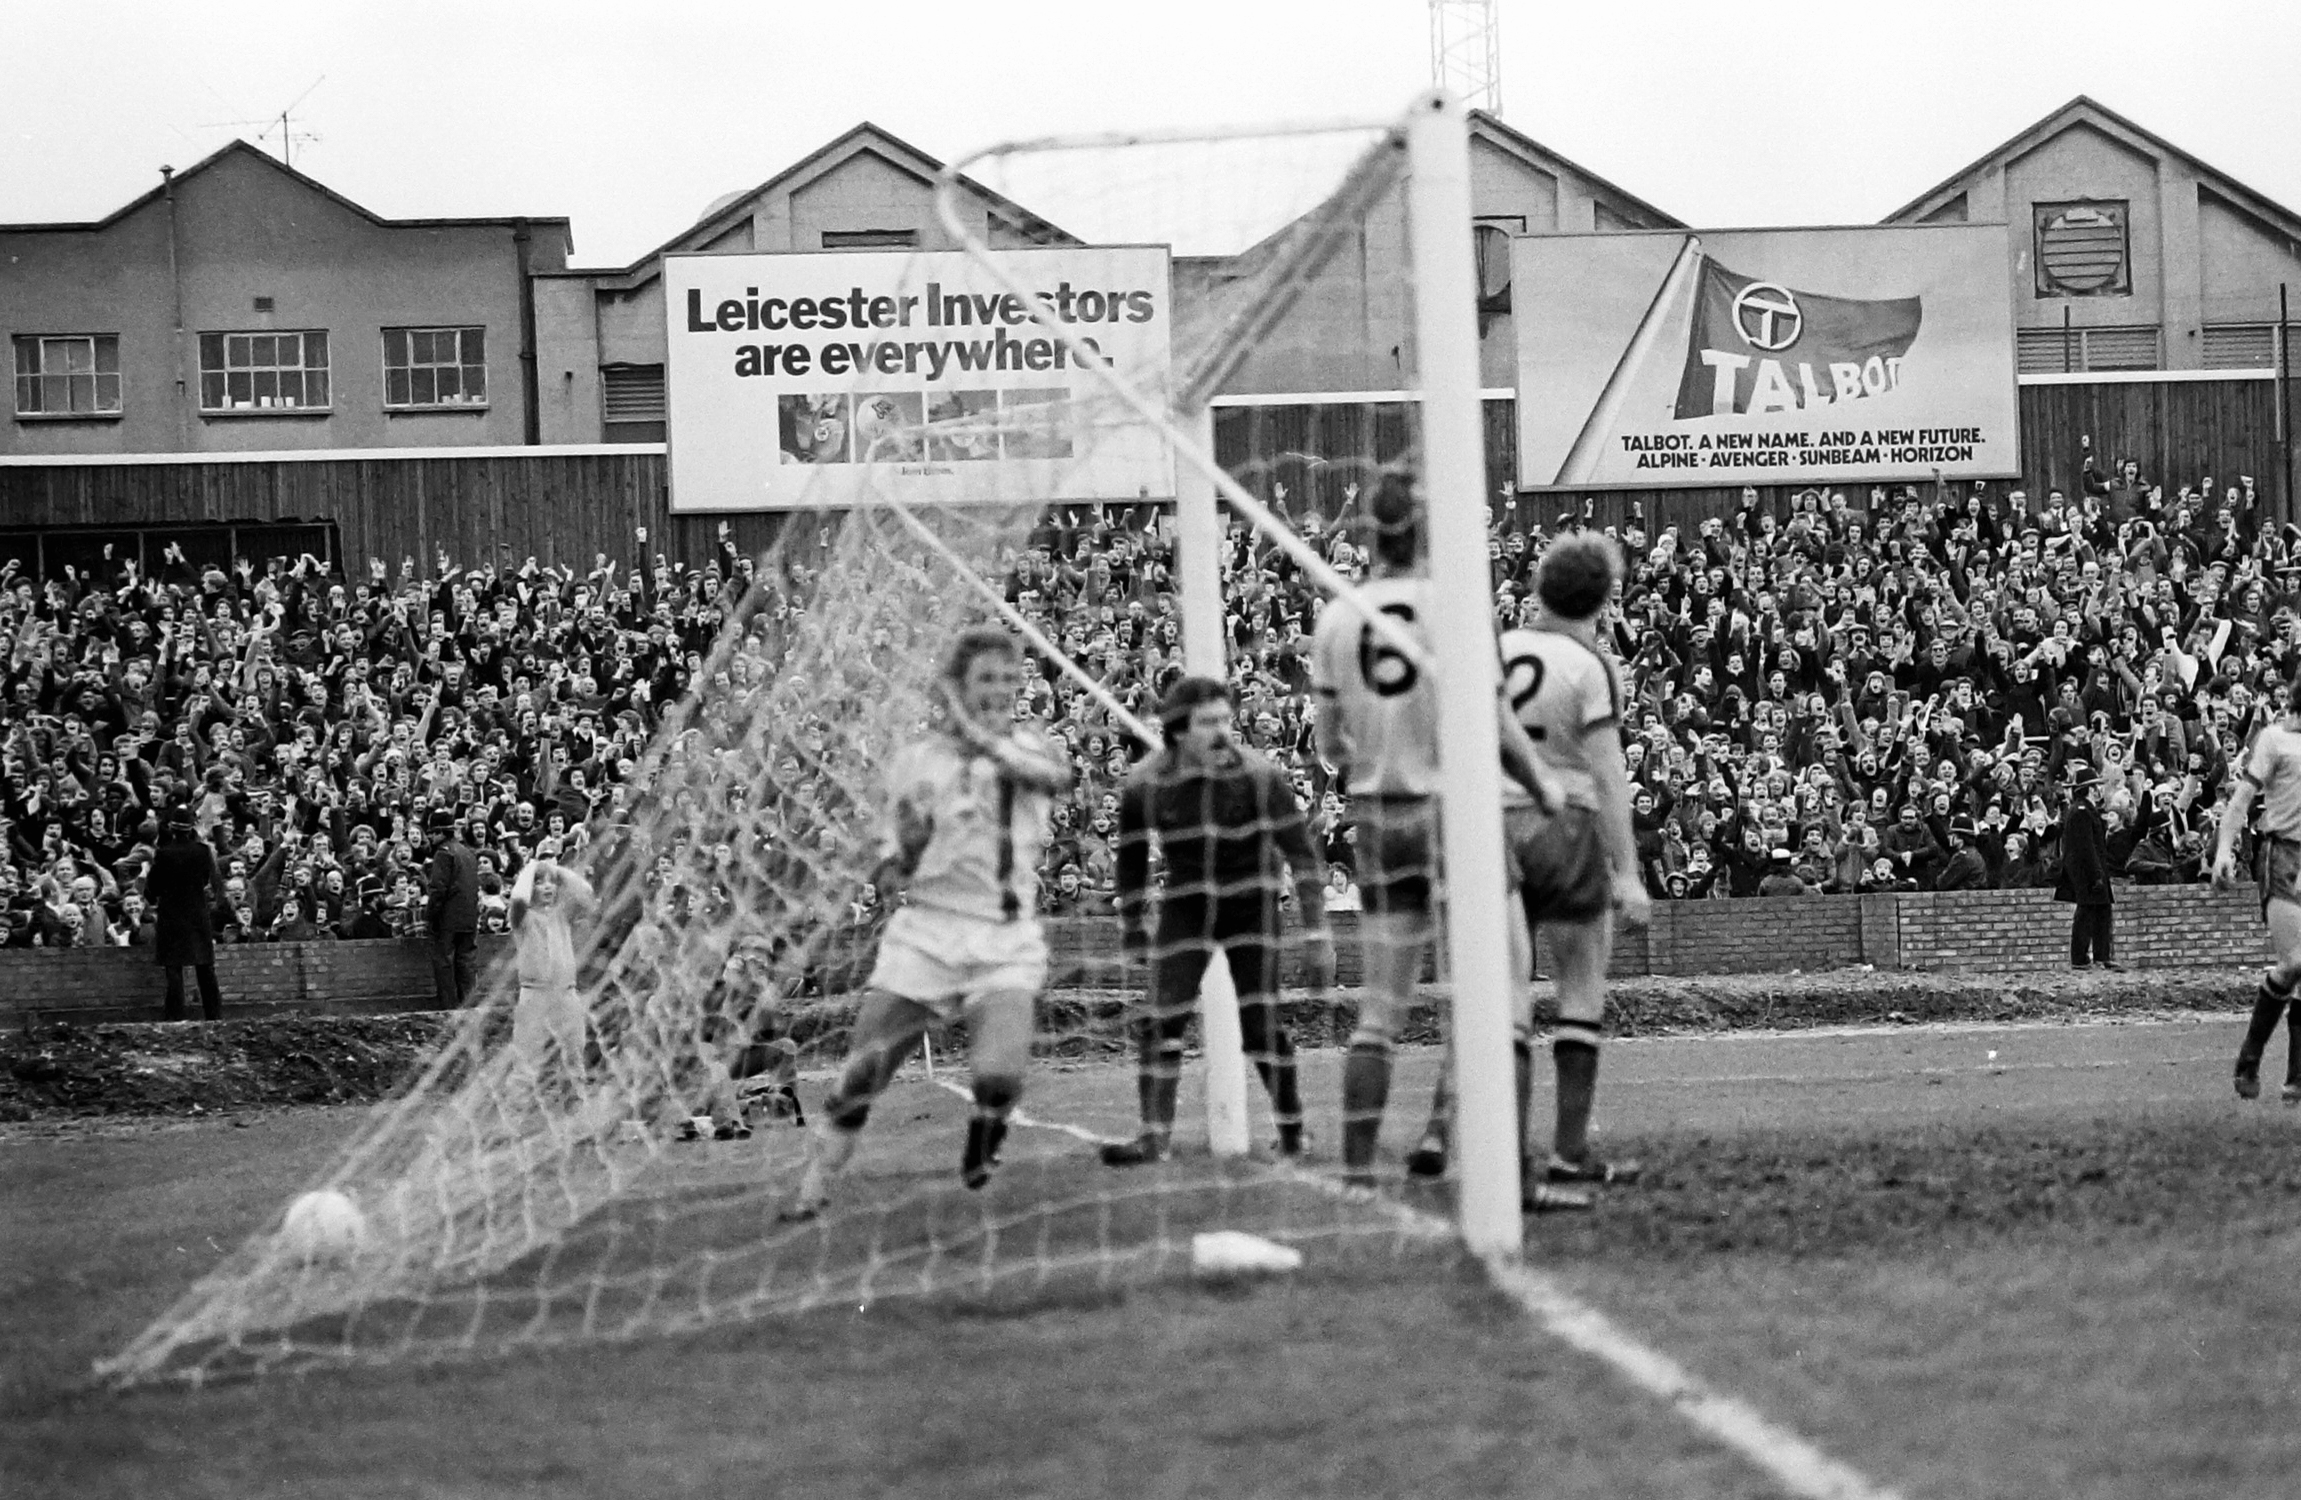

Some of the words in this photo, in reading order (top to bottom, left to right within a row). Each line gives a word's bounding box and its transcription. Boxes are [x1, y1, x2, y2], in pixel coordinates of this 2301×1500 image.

[687, 286, 919, 333] Leicester
[734, 343, 811, 378] are
[1700, 349, 1901, 415] TALBOT
[1621, 434, 1693, 451] TALBOT.
[1698, 434, 1712, 449] A
[1716, 433, 1753, 449] NEW
[1757, 432, 1814, 448] NAME.
[1818, 431, 1856, 447] AND
[1860, 430, 1874, 446] A
[1878, 429, 1914, 445] NEW
[1919, 427, 1986, 445] FUTURE.
[1636, 452, 1699, 469] ALPINE
[1709, 450, 1790, 468] AVENGER
[1799, 448, 1881, 466] SUNBEAM
[1891, 445, 1974, 463] HORIZON
[1359, 602, 1418, 697] 6
[1501, 653, 1548, 742] 2
